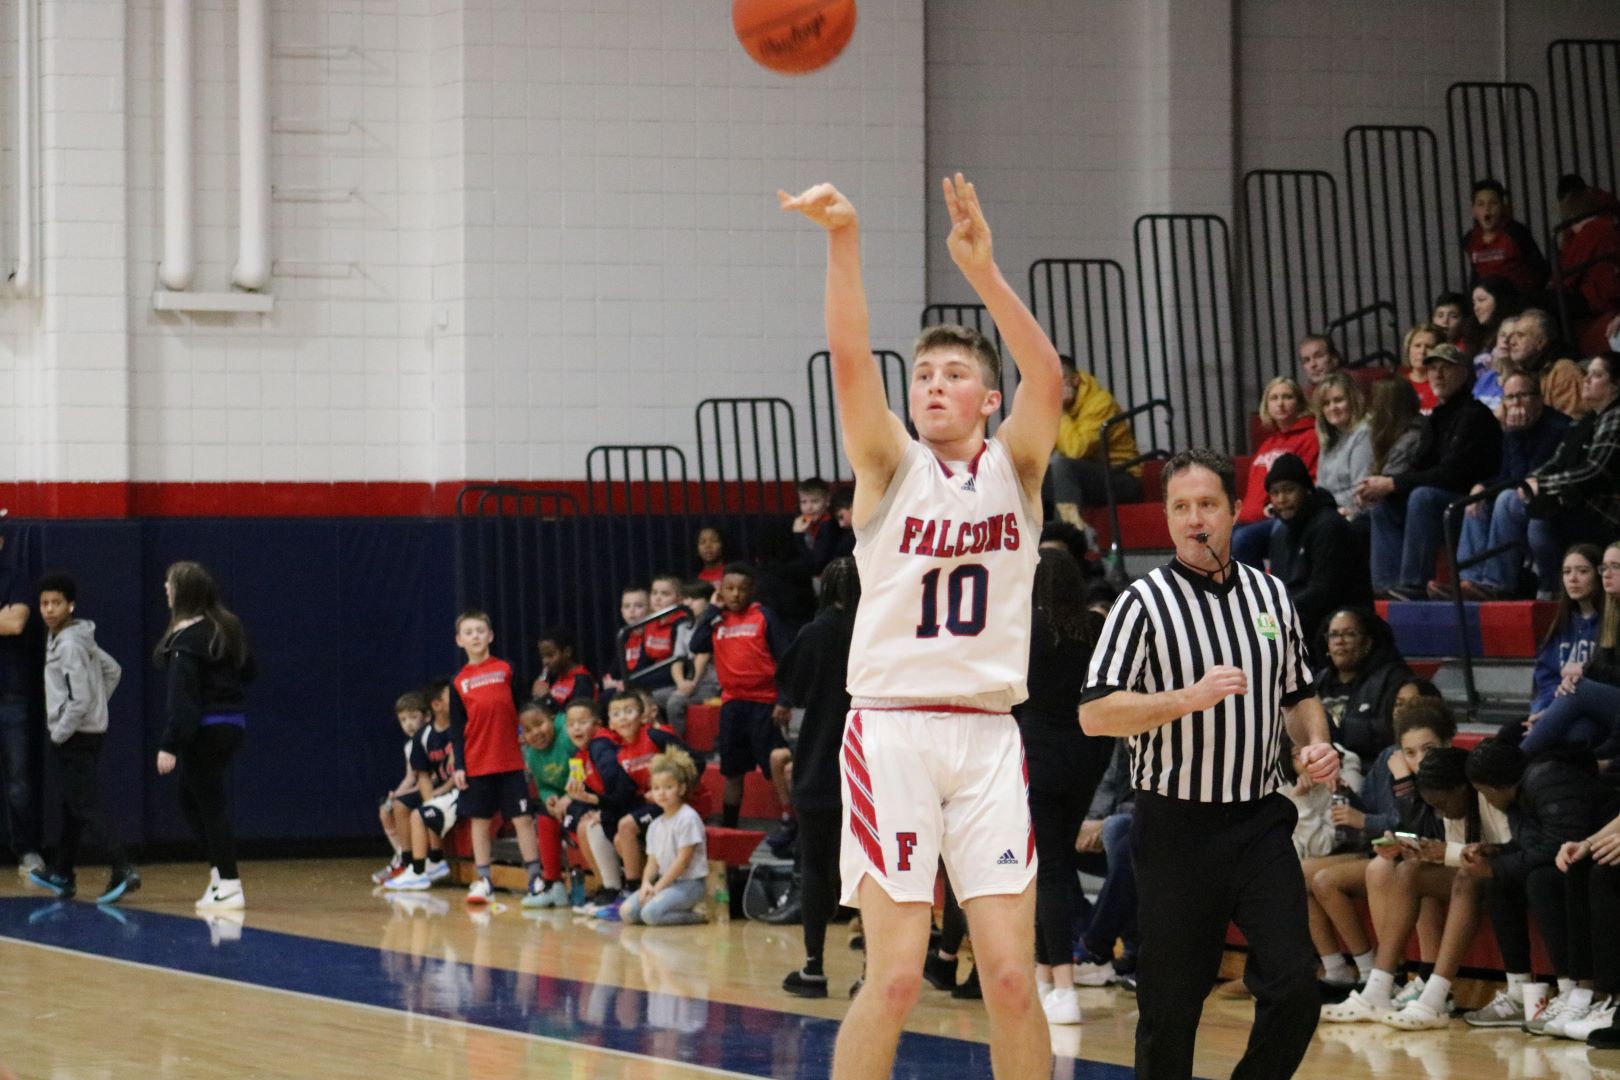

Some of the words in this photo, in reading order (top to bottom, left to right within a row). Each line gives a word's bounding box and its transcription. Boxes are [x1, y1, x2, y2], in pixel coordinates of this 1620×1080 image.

[898, 512, 1020, 558] FALCONS
[916, 563, 989, 638] 10
[896, 832, 917, 871] F
